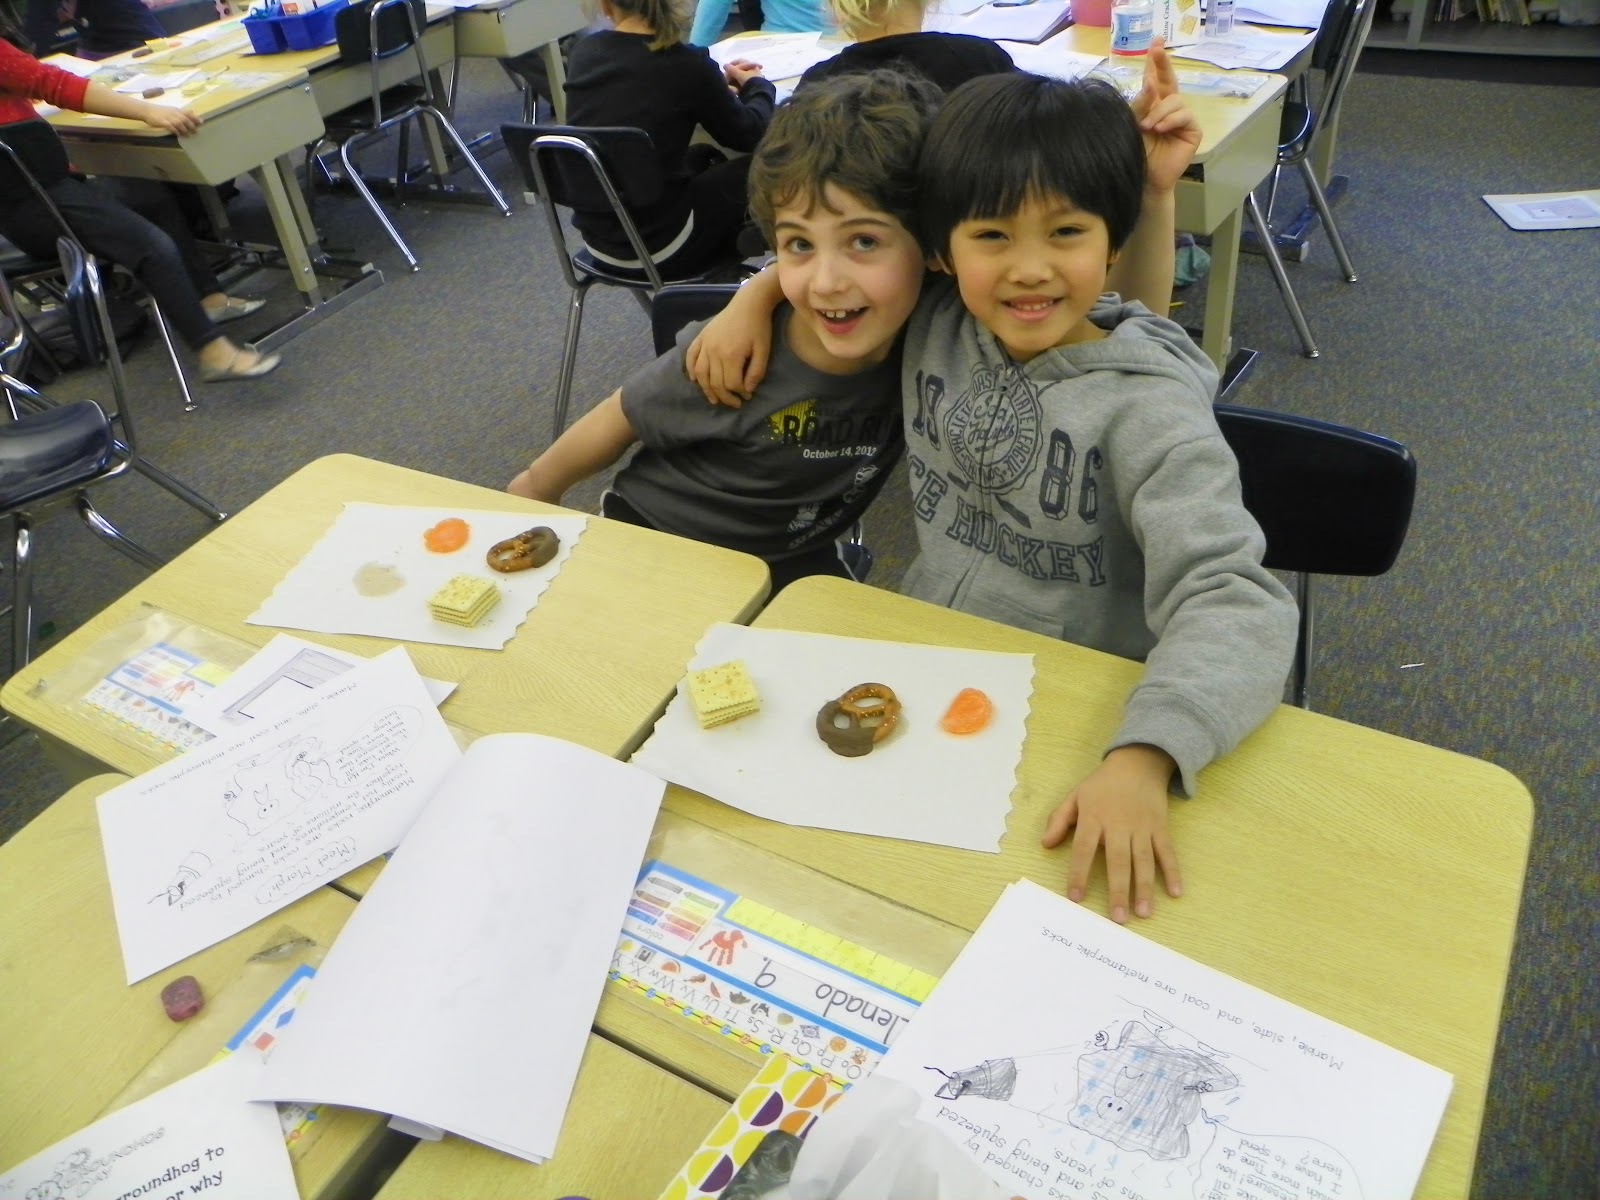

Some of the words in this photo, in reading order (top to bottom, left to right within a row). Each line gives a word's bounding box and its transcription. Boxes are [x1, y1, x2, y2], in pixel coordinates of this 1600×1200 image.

[972, 372, 1000, 397] OAST
[803, 449, 839, 459] October
[840, 447, 853, 457] 14,
[1038, 428, 1104, 525] 86
[945, 495, 1107, 587] HOCKEY
[1041, 926, 1073, 948] rocks.
[1076, 944, 1149, 984] metamorphic
[1154, 980, 1177, 996] are
[1181, 993, 1210, 1011] coal
[815, 983, 910, 1046] lenado
[1216, 1009, 1243, 1025] and
[1251, 1022, 1285, 1043] slate,
[1292, 1036, 1344, 1071] Marble,
[935, 1106, 1007, 1149] squeezed
[205, 1146, 225, 1162] to
[962, 1134, 981, 1155] by
[1222, 1147, 1236, 1160] do
[1238, 1139, 1271, 1157] spend
[1011, 1138, 1050, 1176] being
[1053, 1147, 1095, 1178] years.
[1274, 1155, 1288, 1169] to
[1300, 1150, 1343, 1181] here?
[982, 1150, 1044, 1190] changed
[1271, 1171, 1301, 1190] more
[1295, 1164, 1323, 1185] have
[190, 1170, 224, 1194] why
[1056, 1171, 1085, 1191] and
[1097, 1176, 1115, 1189] of
